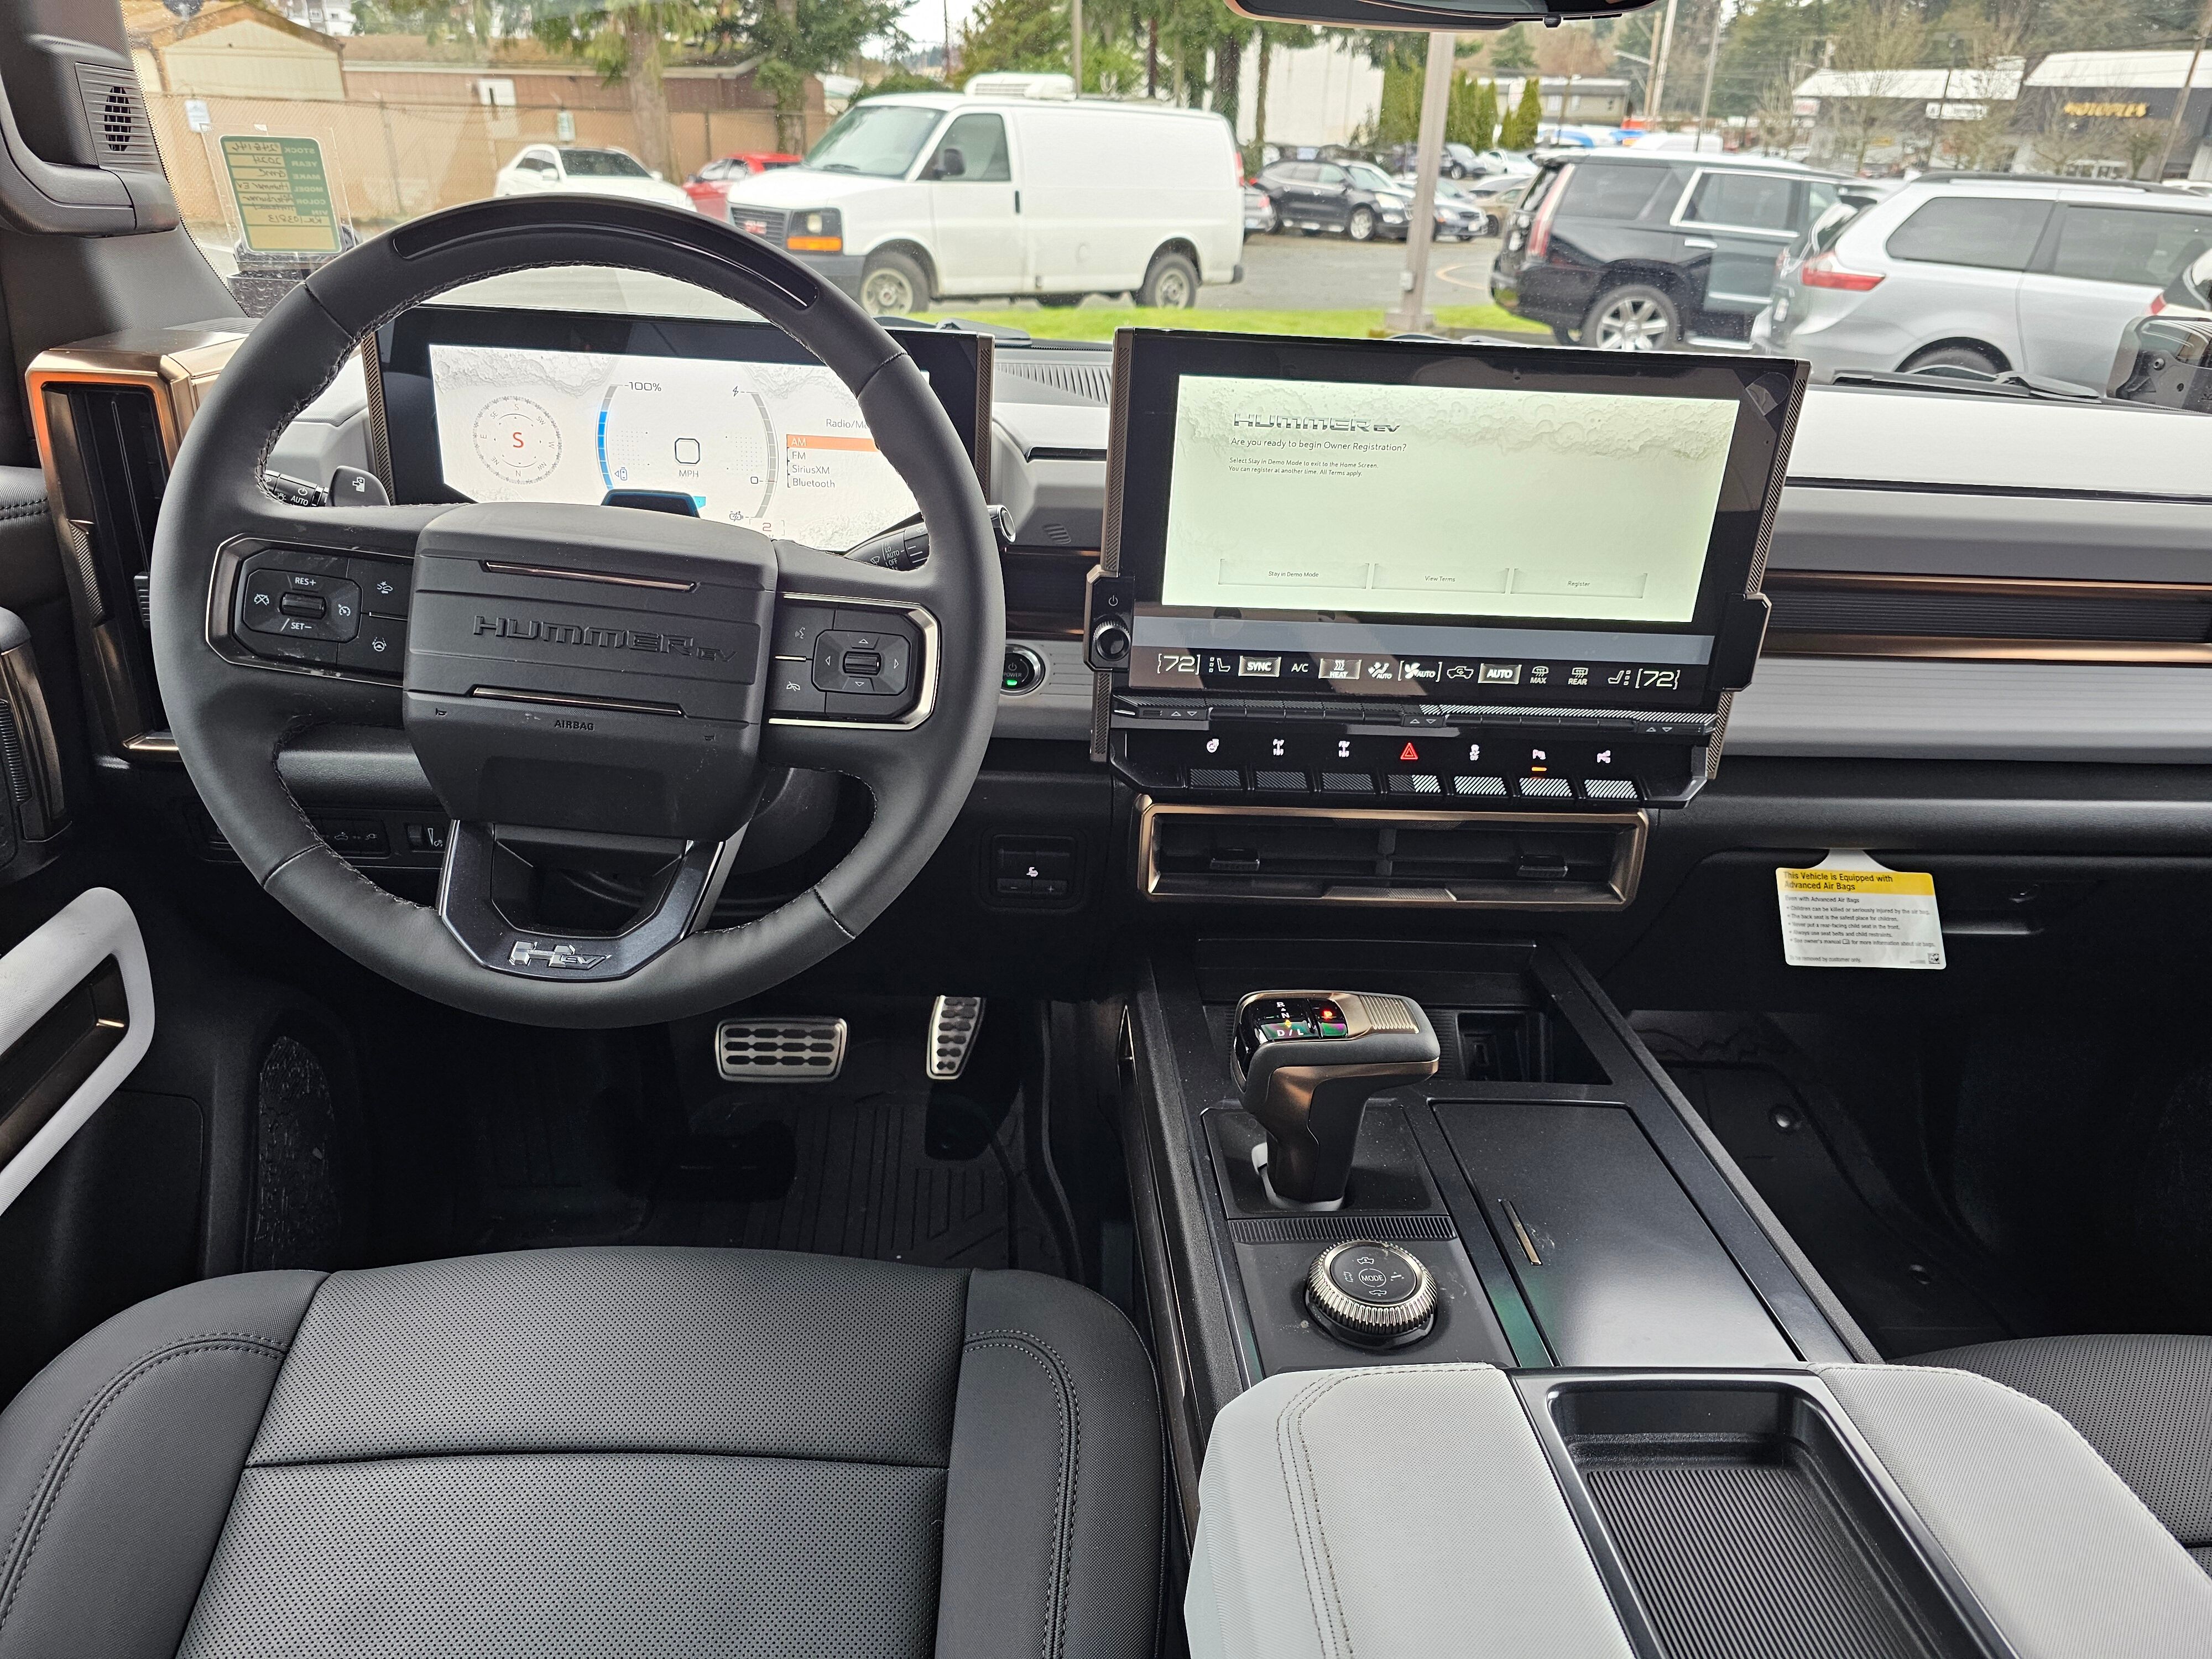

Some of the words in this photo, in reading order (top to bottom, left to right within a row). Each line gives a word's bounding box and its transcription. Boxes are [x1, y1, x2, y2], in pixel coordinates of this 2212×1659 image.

[490, 411, 498, 419] SE
[536, 416, 546, 425] SW
[826, 419, 866, 429] Radio/M
[1234, 414, 1371, 432] HUMMER
[513, 432, 524, 448] S
[791, 438, 806, 446] AM
[1264, 439, 1286, 448] ready
[1299, 440, 1322, 450] begin
[1324, 441, 1350, 450] Owner
[1353, 442, 1407, 452] Registration?
[491, 456, 499, 465] NE
[792, 451, 806, 460] FM
[792, 465, 830, 474] SiriusXM
[793, 478, 835, 488] Bluetooth
[290, 495, 309, 506] AUTO
[763, 523, 772, 531] 2
[887, 550, 900, 560] AUTO
[473, 615, 694, 656] HUMMER
[696, 646, 738, 662] EV
[1246, 661, 1272, 672] SYNC
[1291, 663, 1309, 673] A/C
[1417, 670, 1436, 679] AUTO
[1486, 668, 1513, 679] AUTO
[554, 719, 594, 731] AIRBAG
[1801, 872, 1828, 880] Vehicle
[1839, 873, 1874, 883] Equipped
[1785, 880, 1821, 889] Advanced
[1837, 883, 1855, 891] Bags
